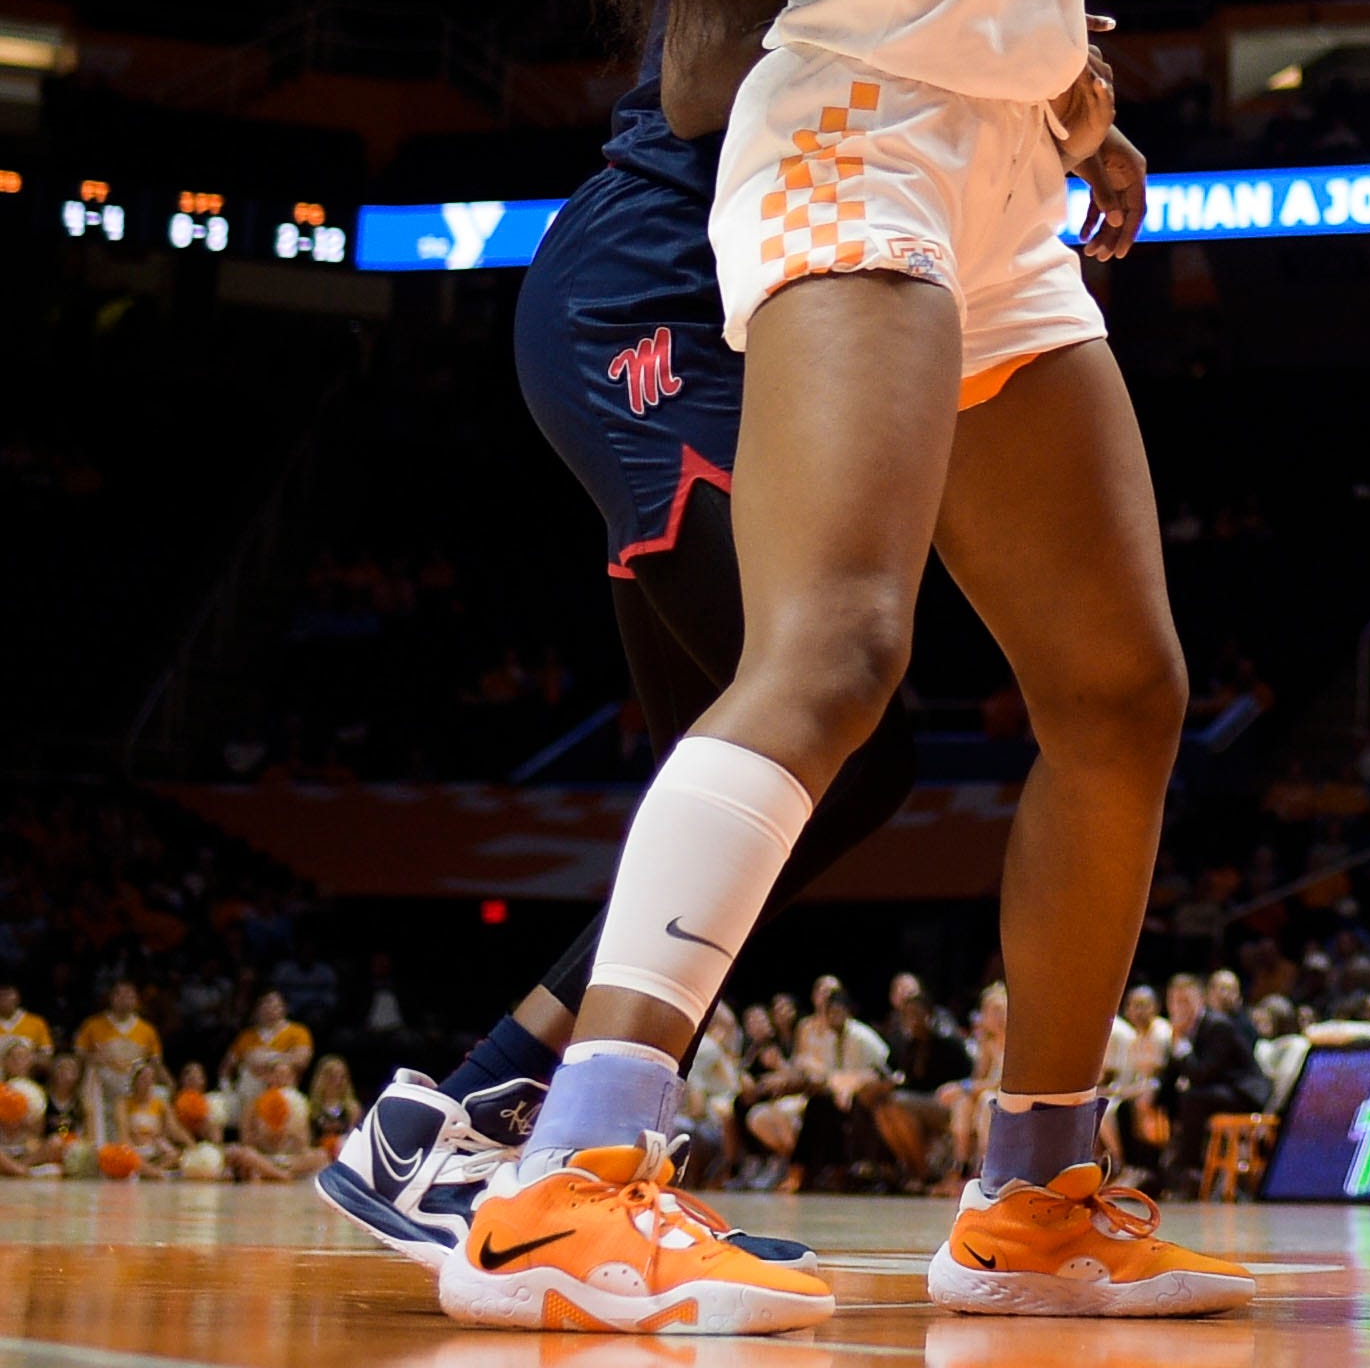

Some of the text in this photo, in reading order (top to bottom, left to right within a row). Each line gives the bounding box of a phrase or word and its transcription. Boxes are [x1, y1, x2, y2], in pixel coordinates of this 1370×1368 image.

[1143, 181, 1274, 233] THAN
[1280, 180, 1320, 226] A
[607, 326, 683, 415] M
